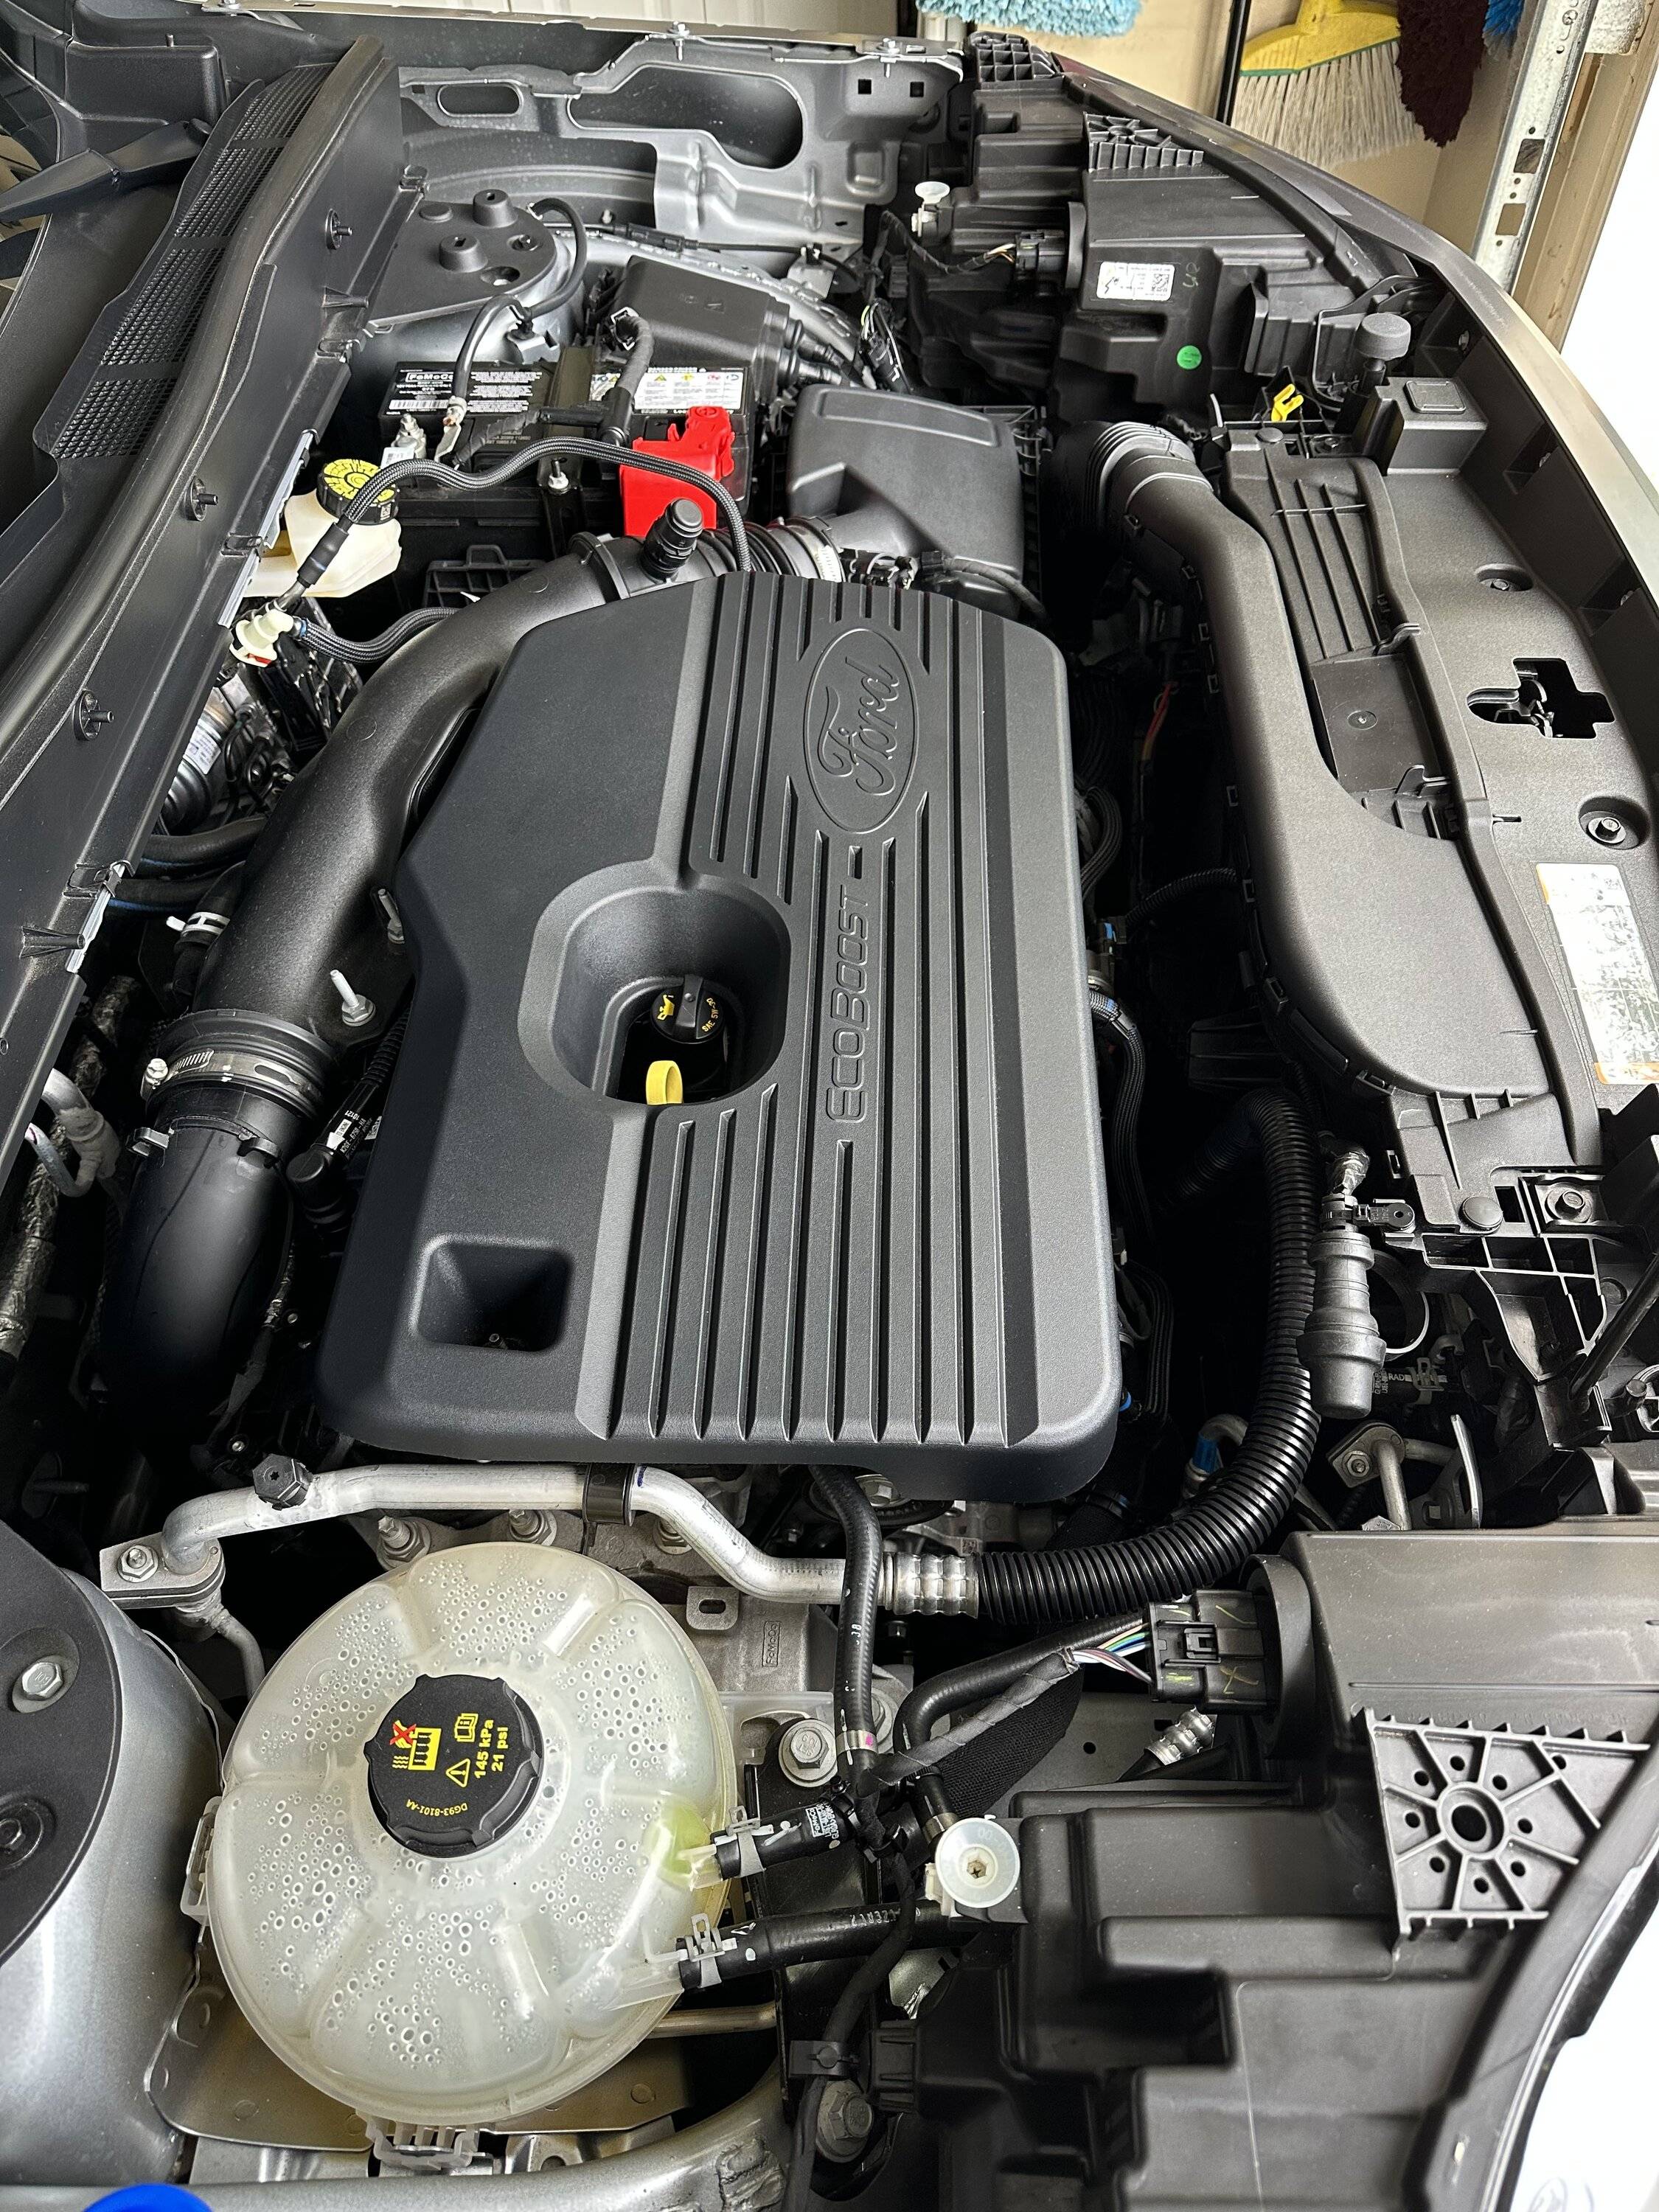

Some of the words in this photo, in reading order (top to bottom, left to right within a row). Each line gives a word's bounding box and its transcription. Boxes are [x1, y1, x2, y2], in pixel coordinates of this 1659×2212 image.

[817, 655, 900, 796] Ford
[706, 998, 719, 1019] 5W-30
[701, 1020, 715, 1032] SAE
[1388, 1373, 1405, 1381] RAD
[766, 1624, 778, 1664] FoMoCo
[479, 1719, 494, 1747] kPa
[497, 1727, 509, 1749] psi
[474, 1750, 490, 1778] 145
[491, 1754, 505, 1772] 21
[406, 1798, 468, 1817] DG93-8101-AA
